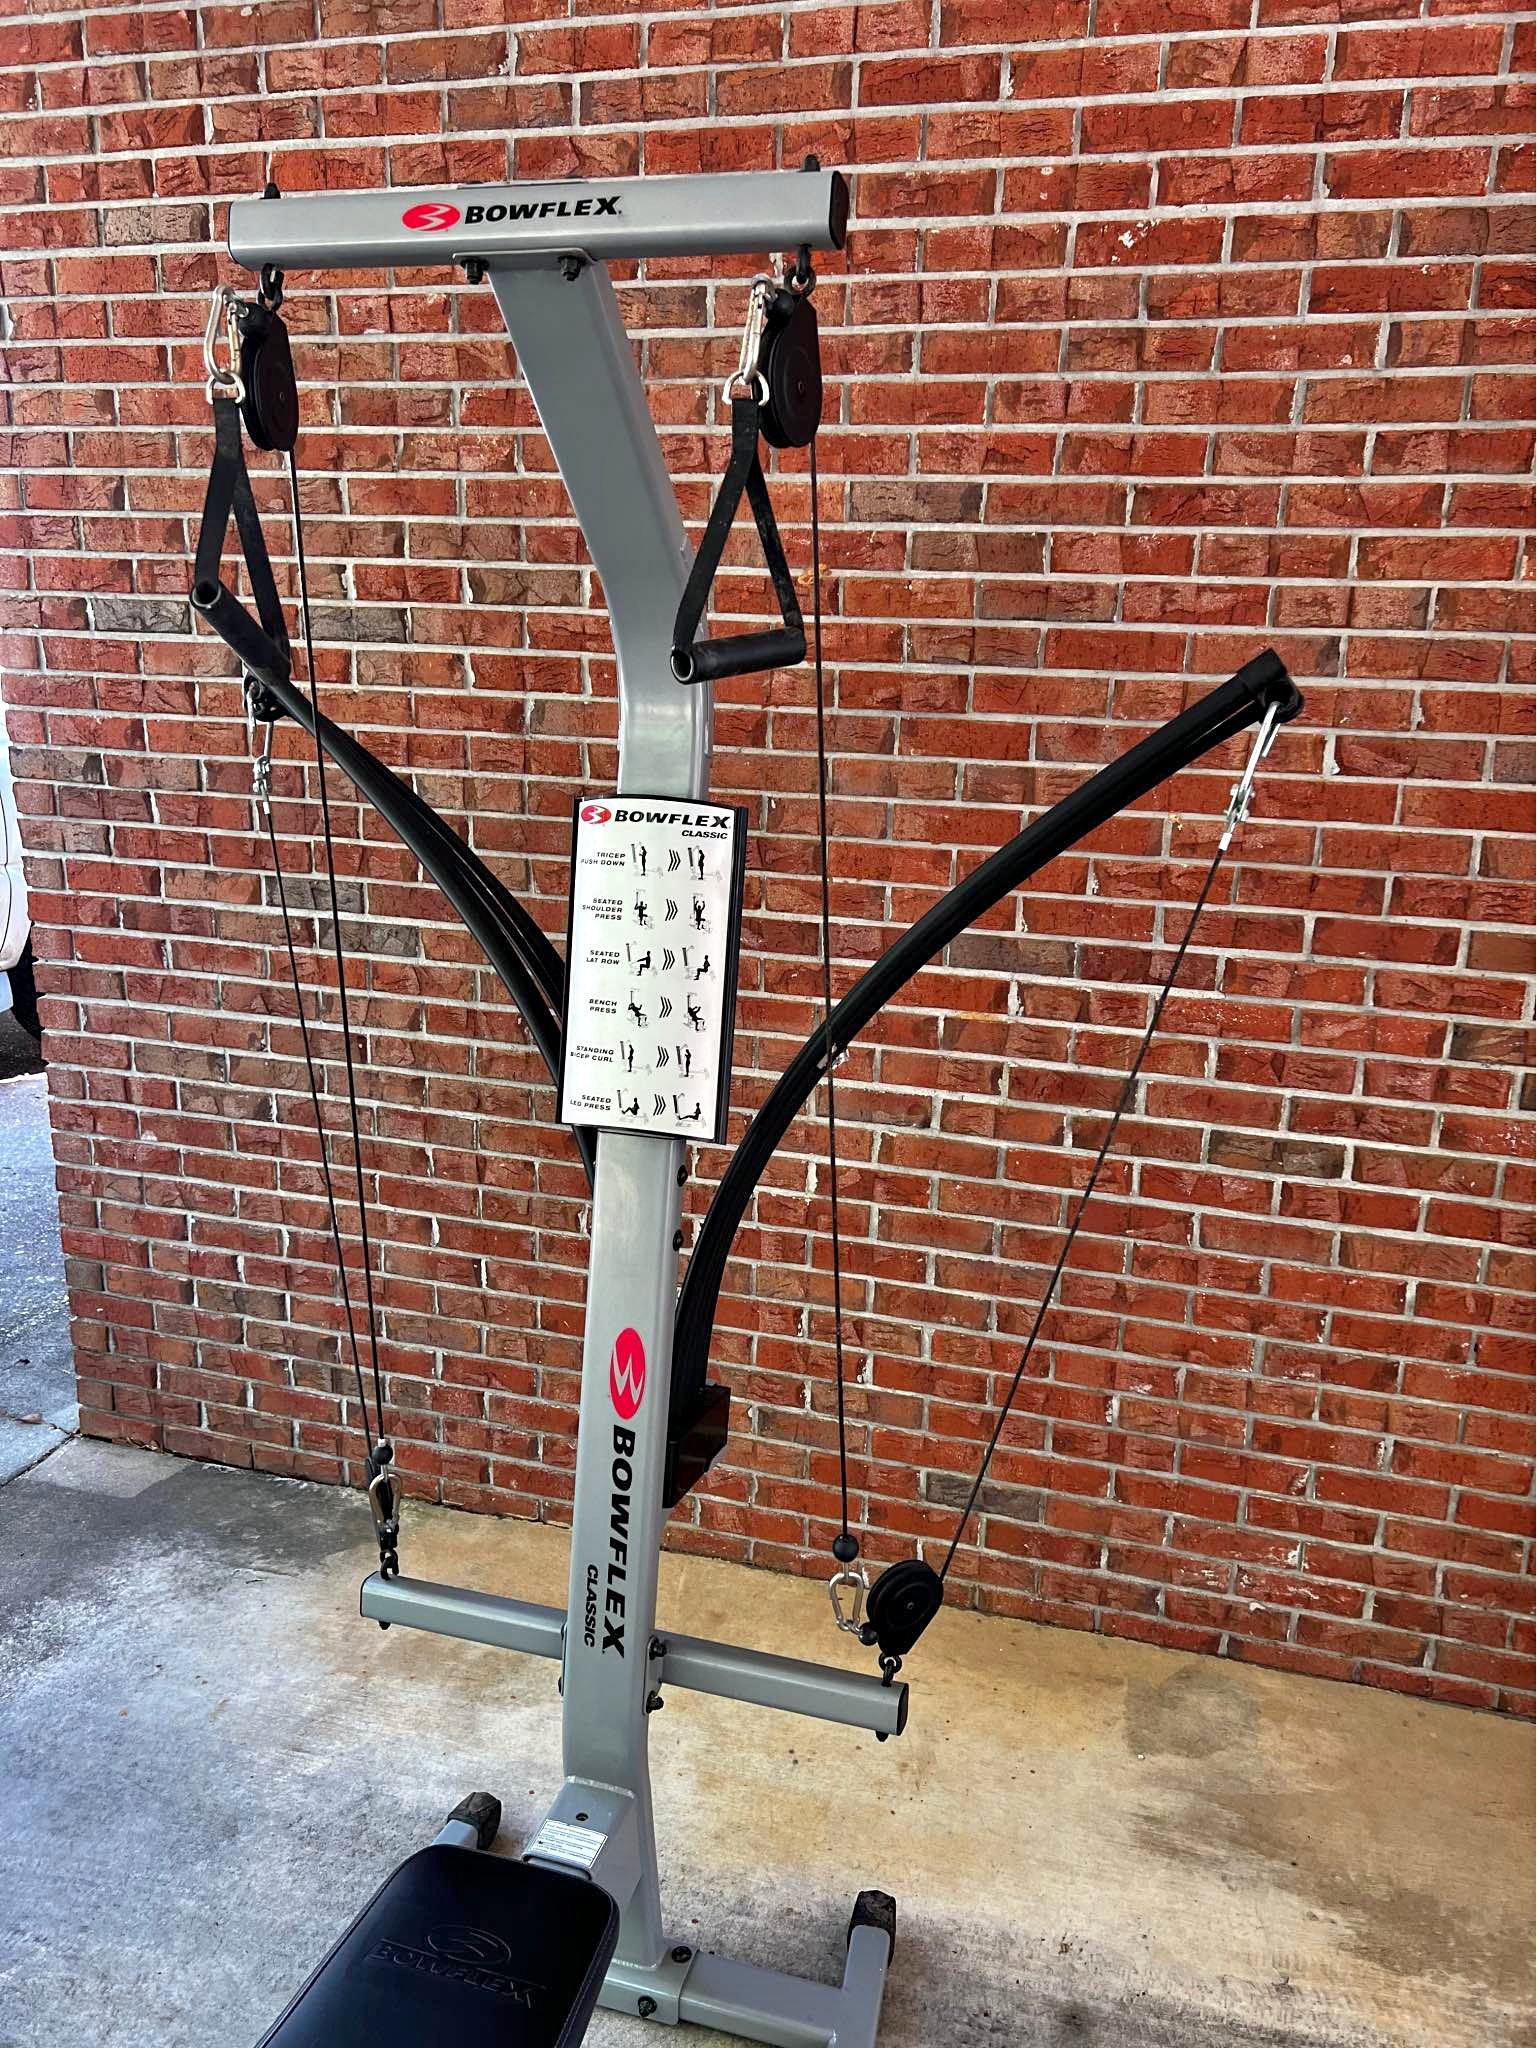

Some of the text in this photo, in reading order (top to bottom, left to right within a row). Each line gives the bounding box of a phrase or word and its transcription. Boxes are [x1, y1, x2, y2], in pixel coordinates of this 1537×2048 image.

[465, 196, 621, 224] BOWFLEX
[614, 809, 730, 829] BOWFLEX
[681, 829, 728, 839] CLASSIC
[600, 859, 625, 867] DOWN
[592, 898, 623, 906] SEATED
[582, 905, 623, 913] SHOULDER
[594, 913, 622, 921] PRESS
[590, 949, 620, 958] SEATED
[589, 998, 617, 1006] BENCH
[589, 1006, 617, 1014] PRESS
[576, 1045, 614, 1055] STANDING
[591, 1054, 614, 1063] CURL
[581, 1094, 612, 1104] SEATED
[583, 1102, 611, 1111] PRESS
[602, 1424, 636, 1659] BOWFLEX
[584, 1564, 598, 1648] CLASSIC
